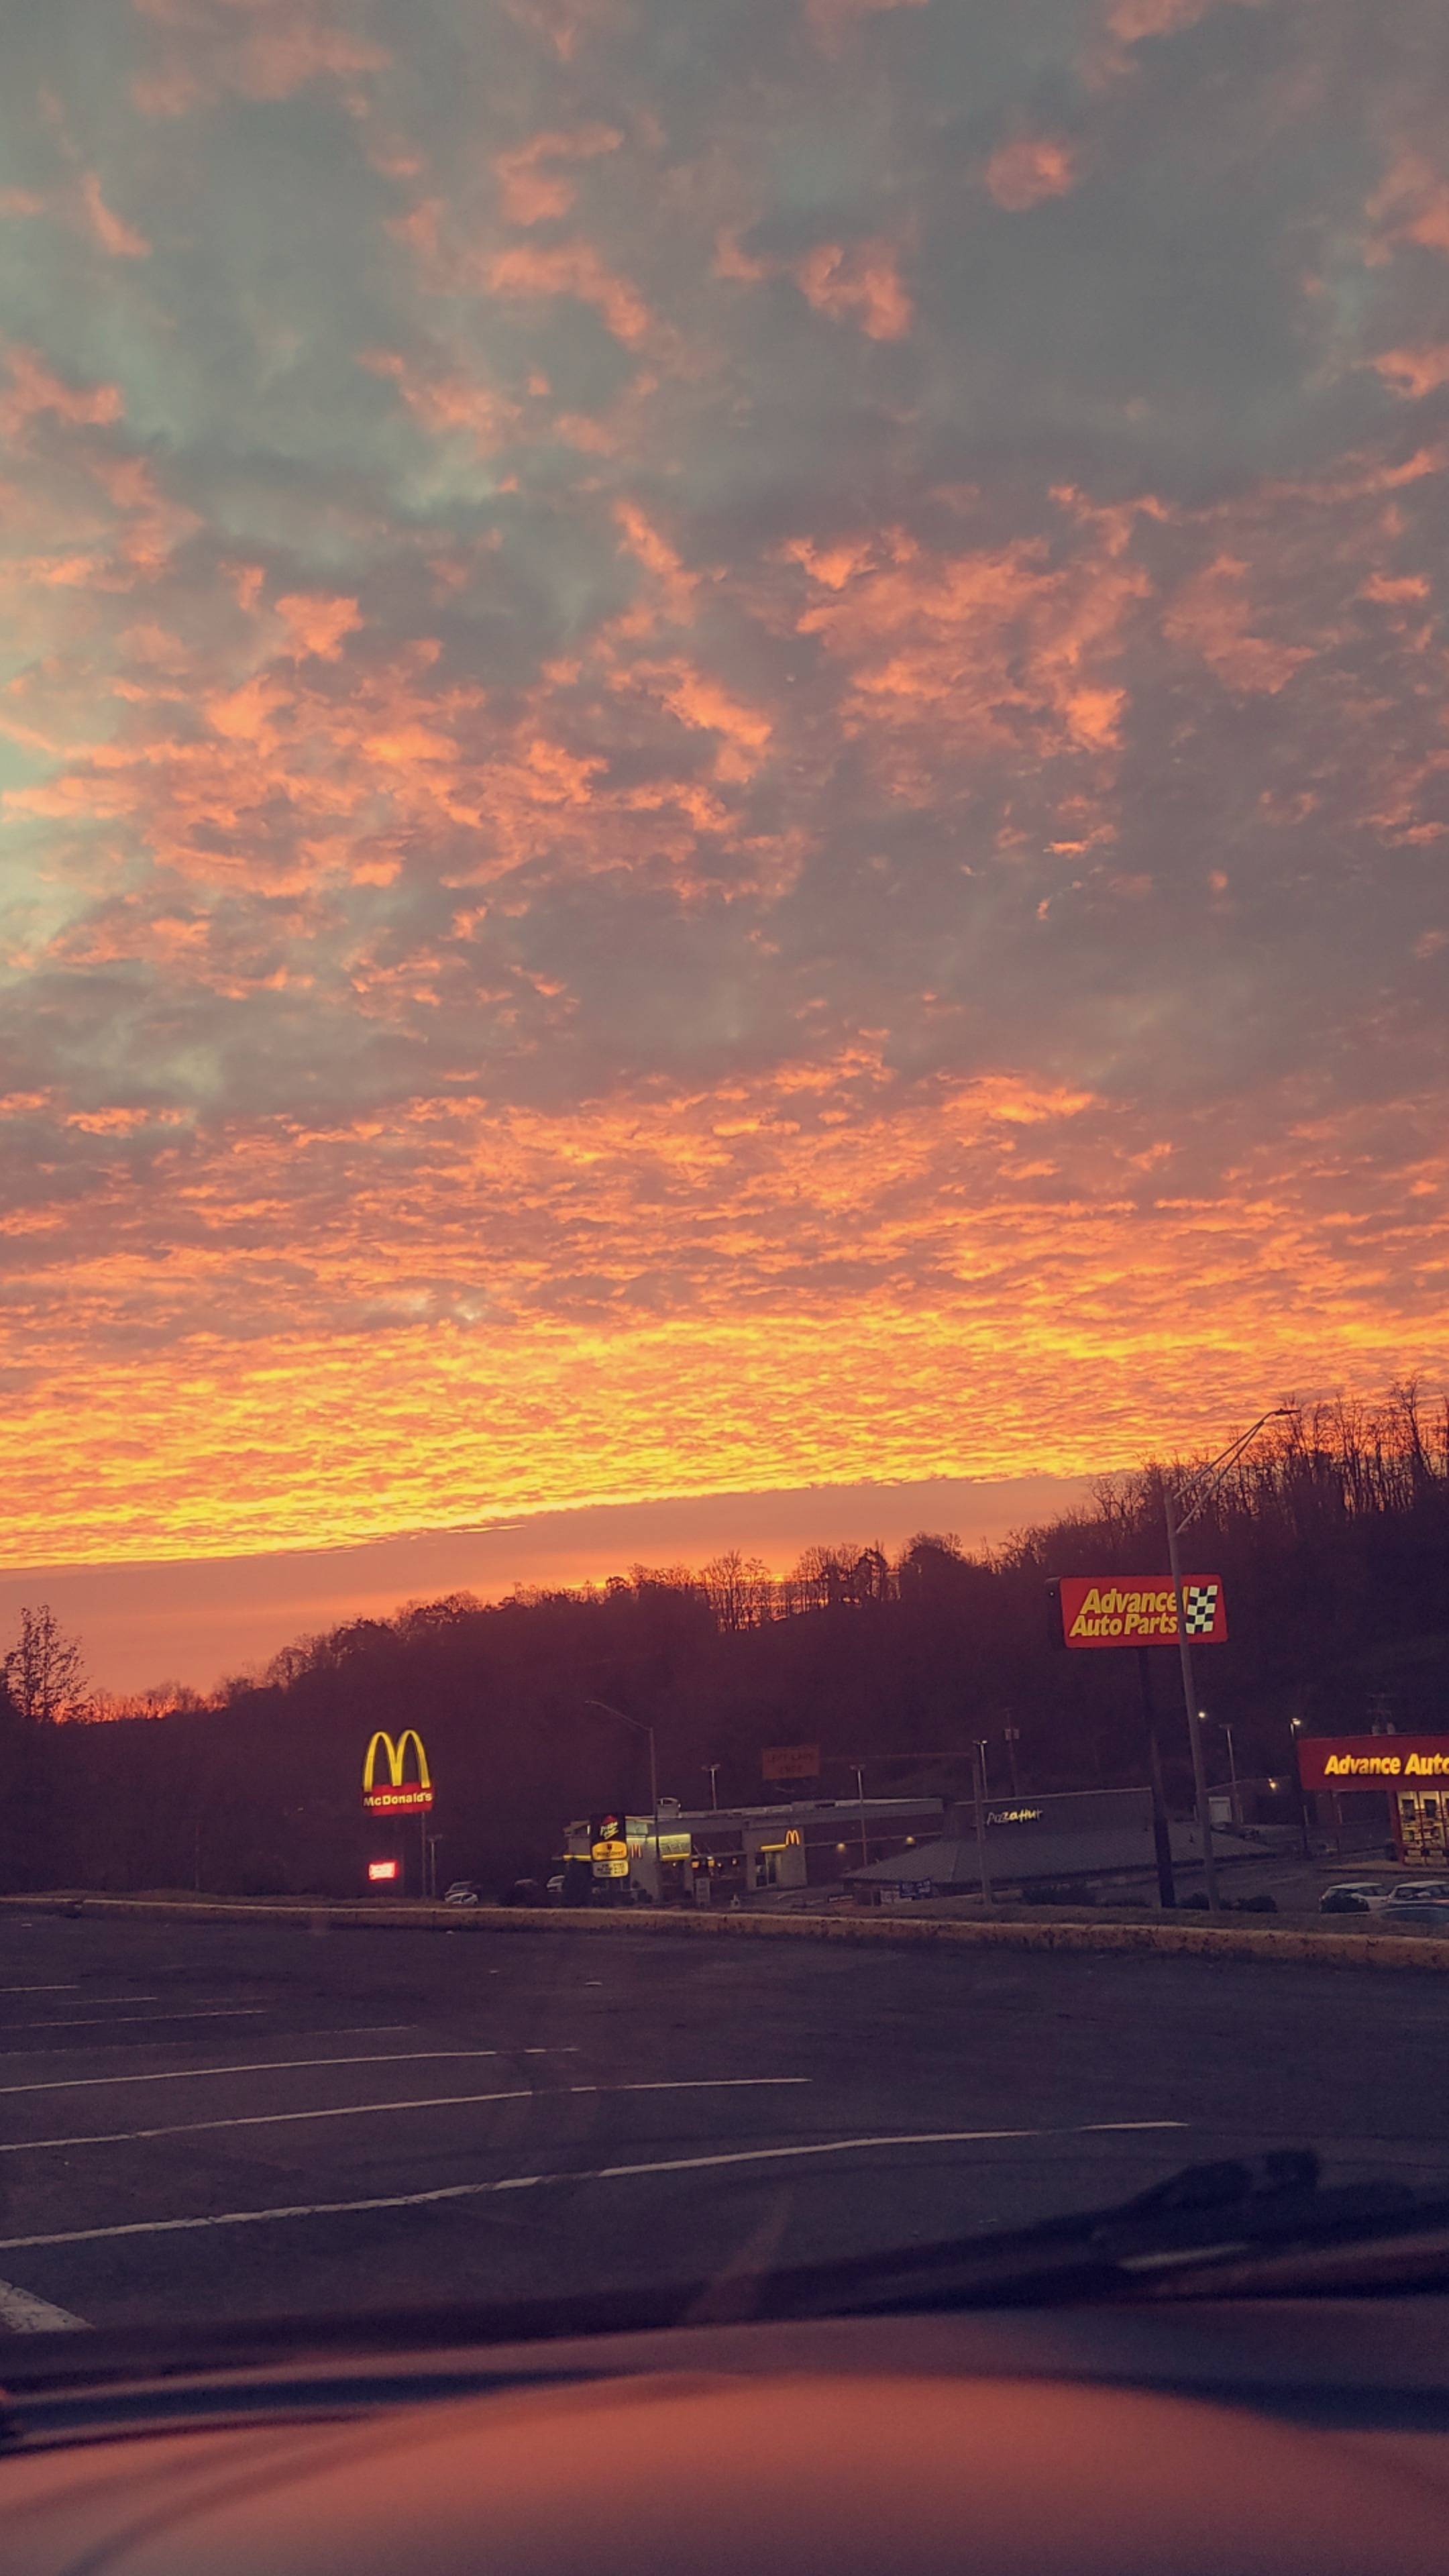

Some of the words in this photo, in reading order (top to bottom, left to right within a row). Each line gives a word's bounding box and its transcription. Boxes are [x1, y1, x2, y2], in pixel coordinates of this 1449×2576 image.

[1079, 1588, 1177, 1615] Advance
[1069, 1614, 1122, 1638] Auto
[1123, 1612, 1178, 1635] Parts
[1324, 1754, 1401, 1775] Advance
[364, 1791, 433, 1807] McDonald's
[987, 1810, 1018, 1826] Pizza
